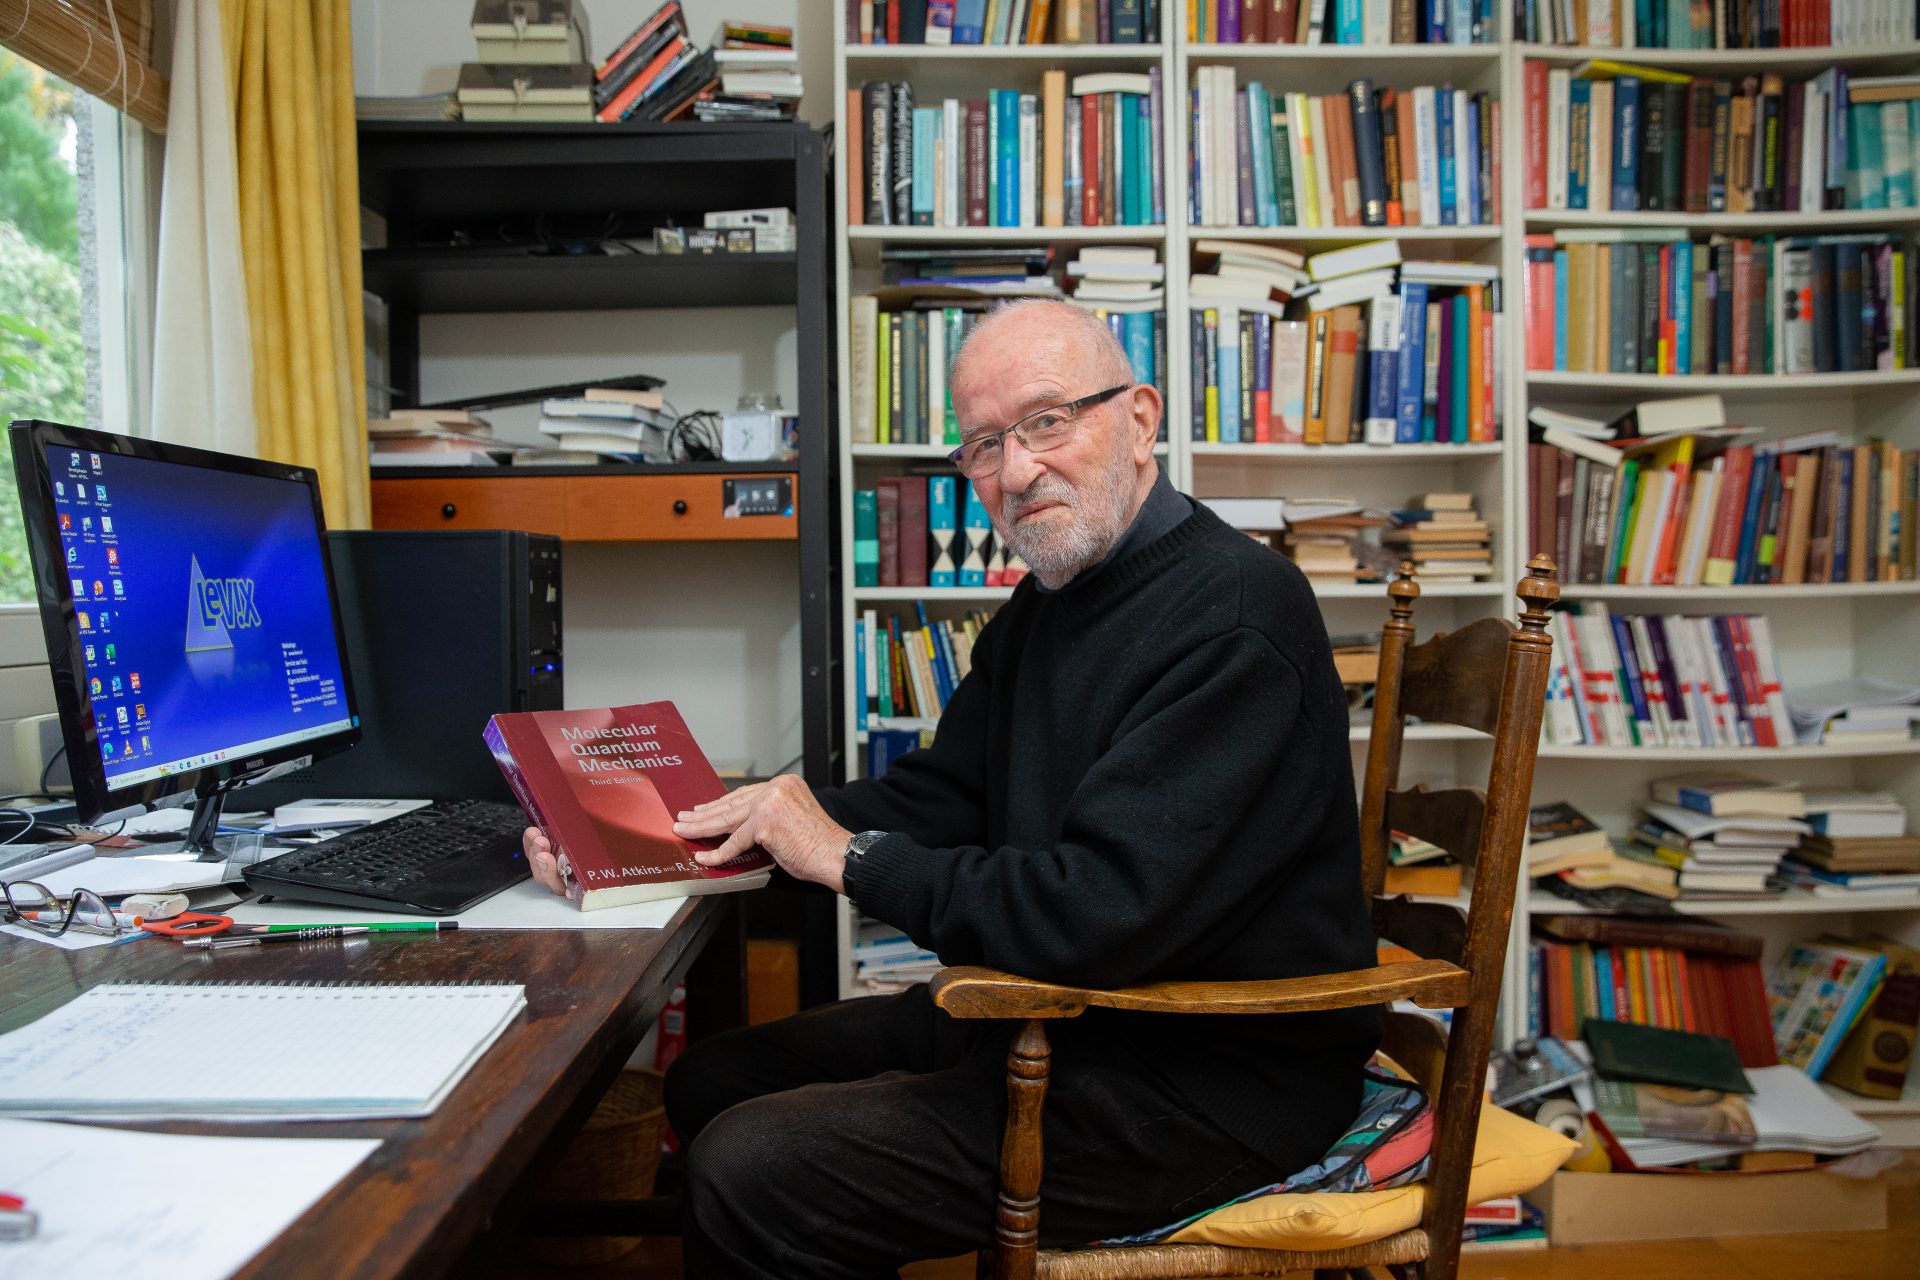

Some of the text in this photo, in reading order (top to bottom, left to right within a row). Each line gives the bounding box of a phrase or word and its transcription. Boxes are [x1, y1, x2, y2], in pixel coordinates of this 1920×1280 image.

[871, 107, 886, 201] GRAVITATION
[560, 723, 657, 741] Molecular
[570, 740, 661, 756] Quantum
[246, 759, 264, 770] PHILIPS
[578, 754, 683, 773] Mechanics
[612, 776, 645, 785] Edition
[621, 864, 662, 877] Atkins
